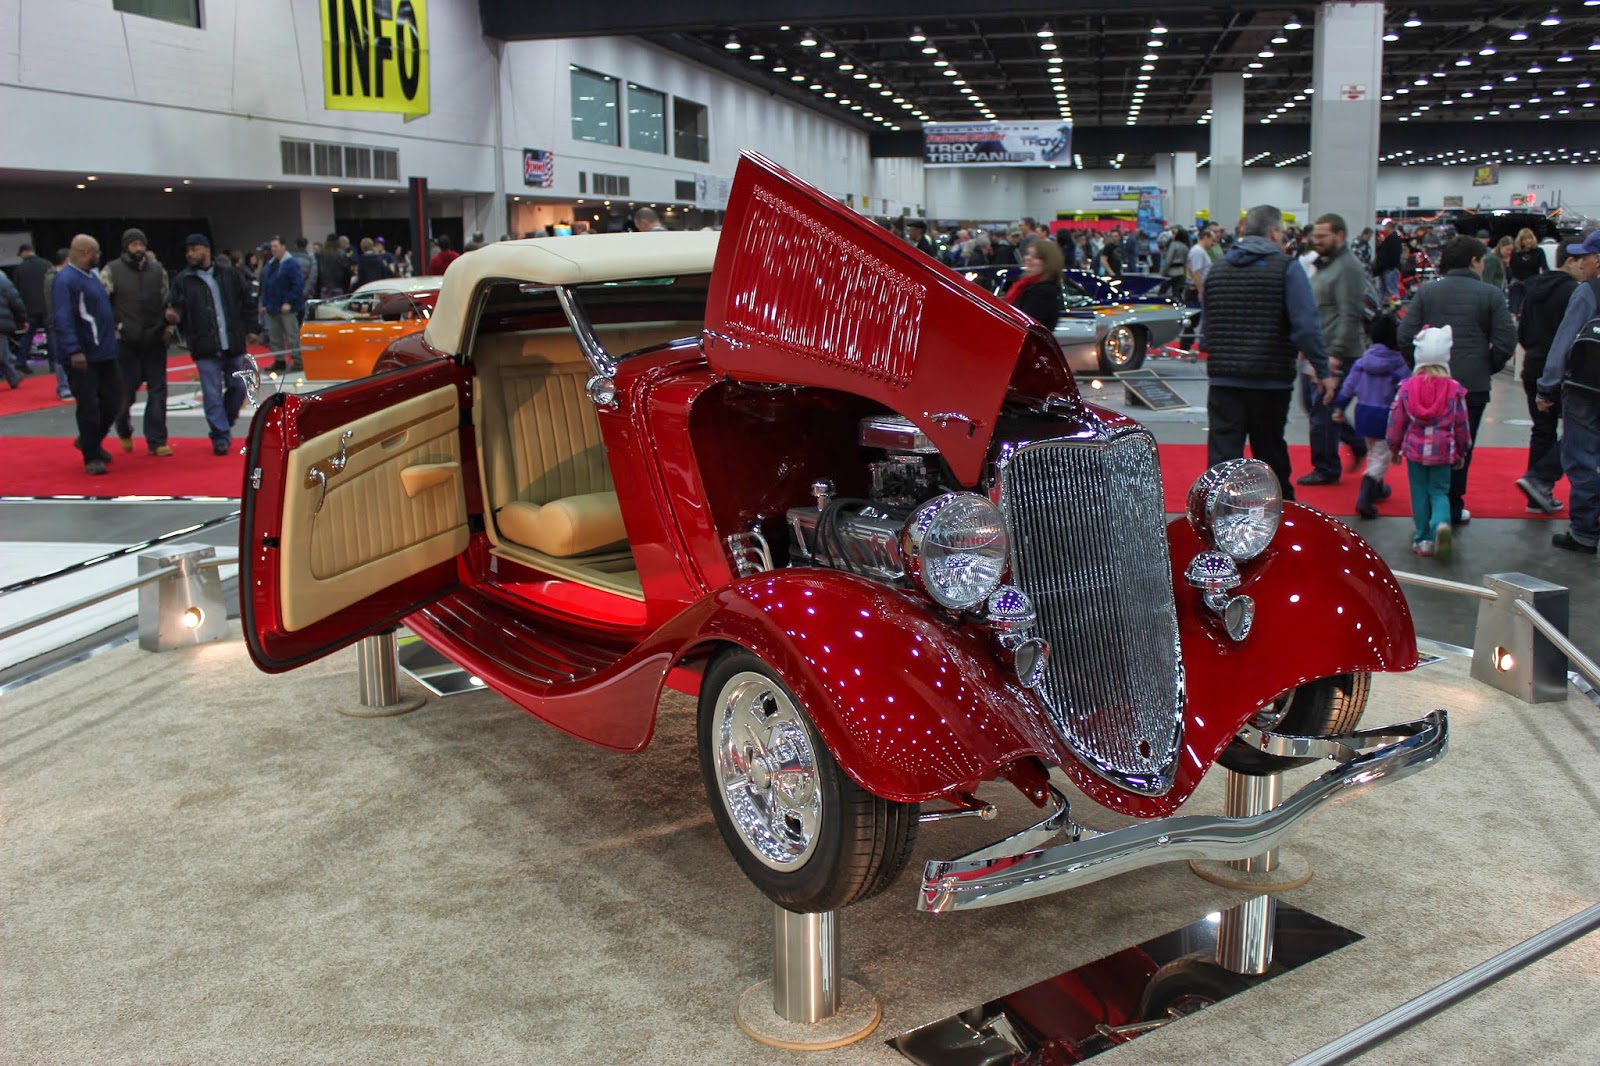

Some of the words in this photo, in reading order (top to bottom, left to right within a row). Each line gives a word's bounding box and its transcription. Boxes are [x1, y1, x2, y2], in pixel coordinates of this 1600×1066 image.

[327, 0, 420, 101] INFO
[927, 143, 979, 153] TROY
[927, 152, 1036, 162] TREPANIER
